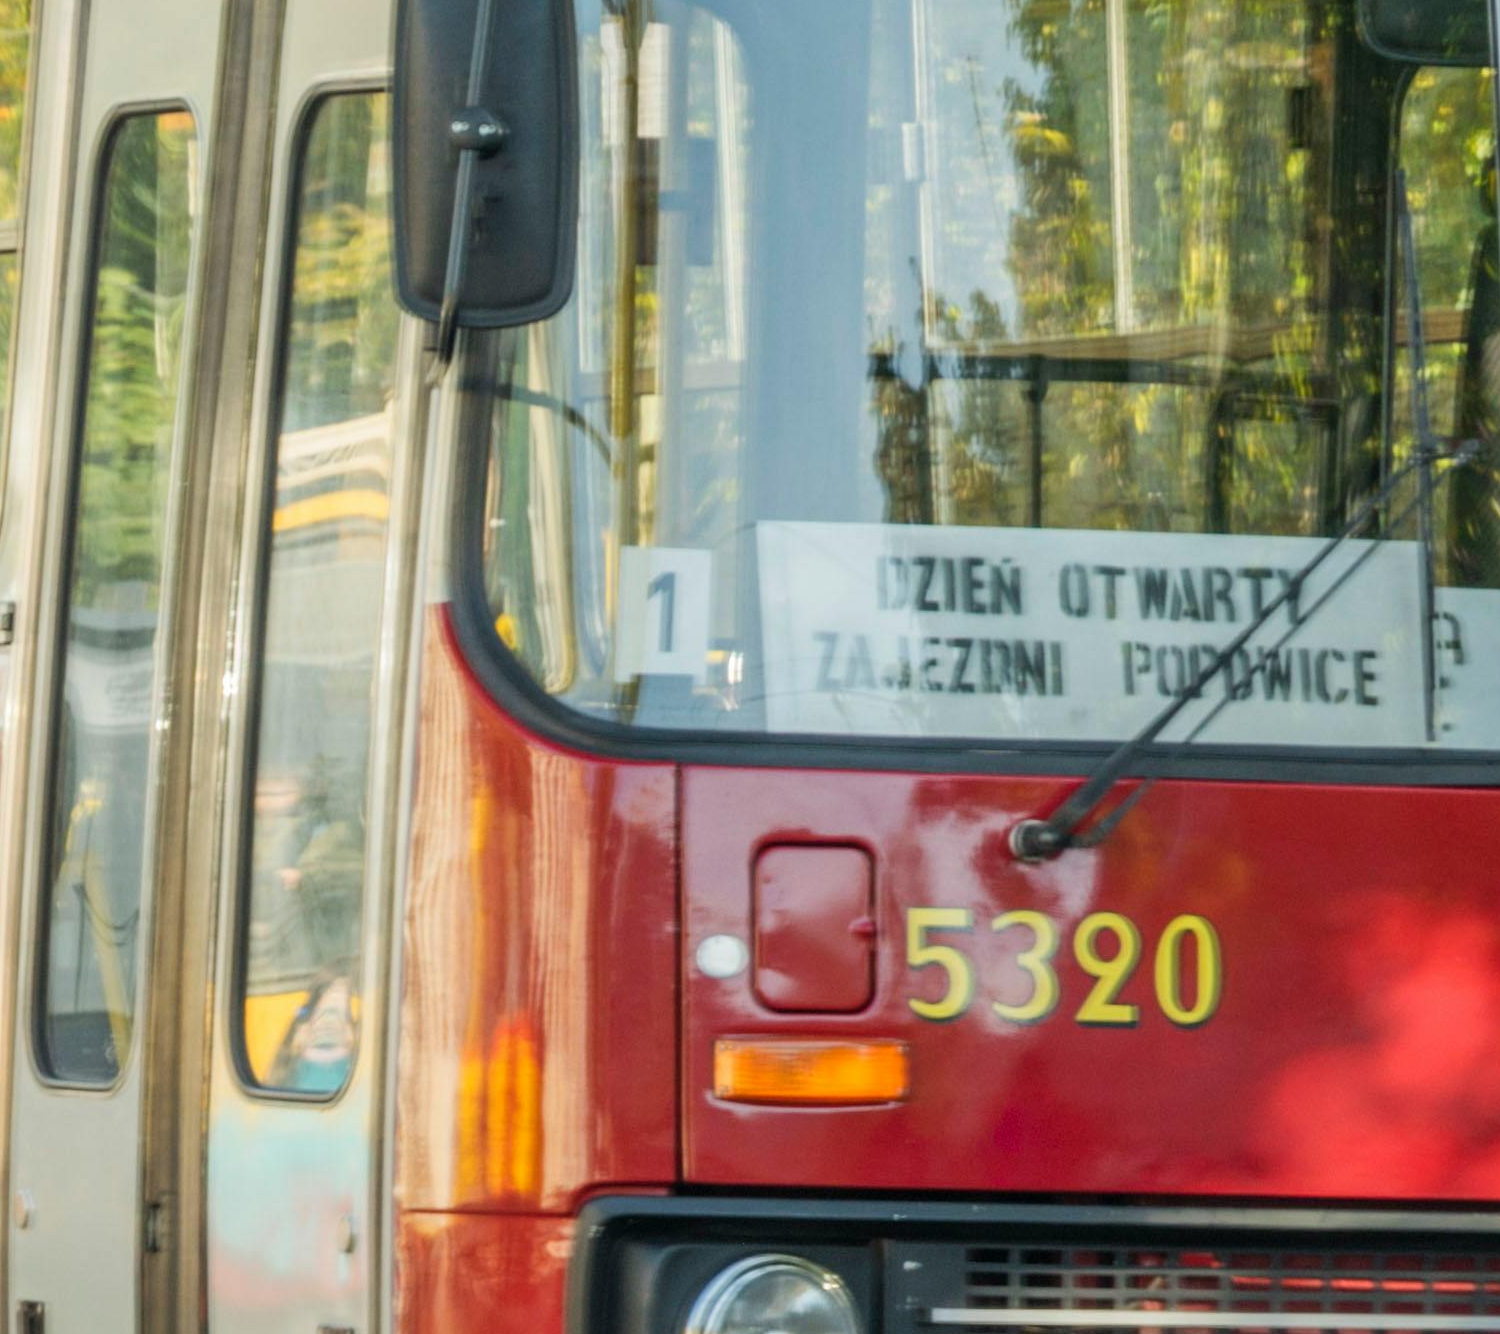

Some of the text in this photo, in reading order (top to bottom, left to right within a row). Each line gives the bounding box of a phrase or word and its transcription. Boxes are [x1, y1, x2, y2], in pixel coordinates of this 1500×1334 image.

[646, 570, 676, 653] 1
[876, 555, 1302, 624] DZIEŃ OTWARTY
[813, 631, 1064, 697] ZAJEZDNI
[1121, 639, 1380, 706] POPOWICE
[906, 907, 1222, 1029] 5320
